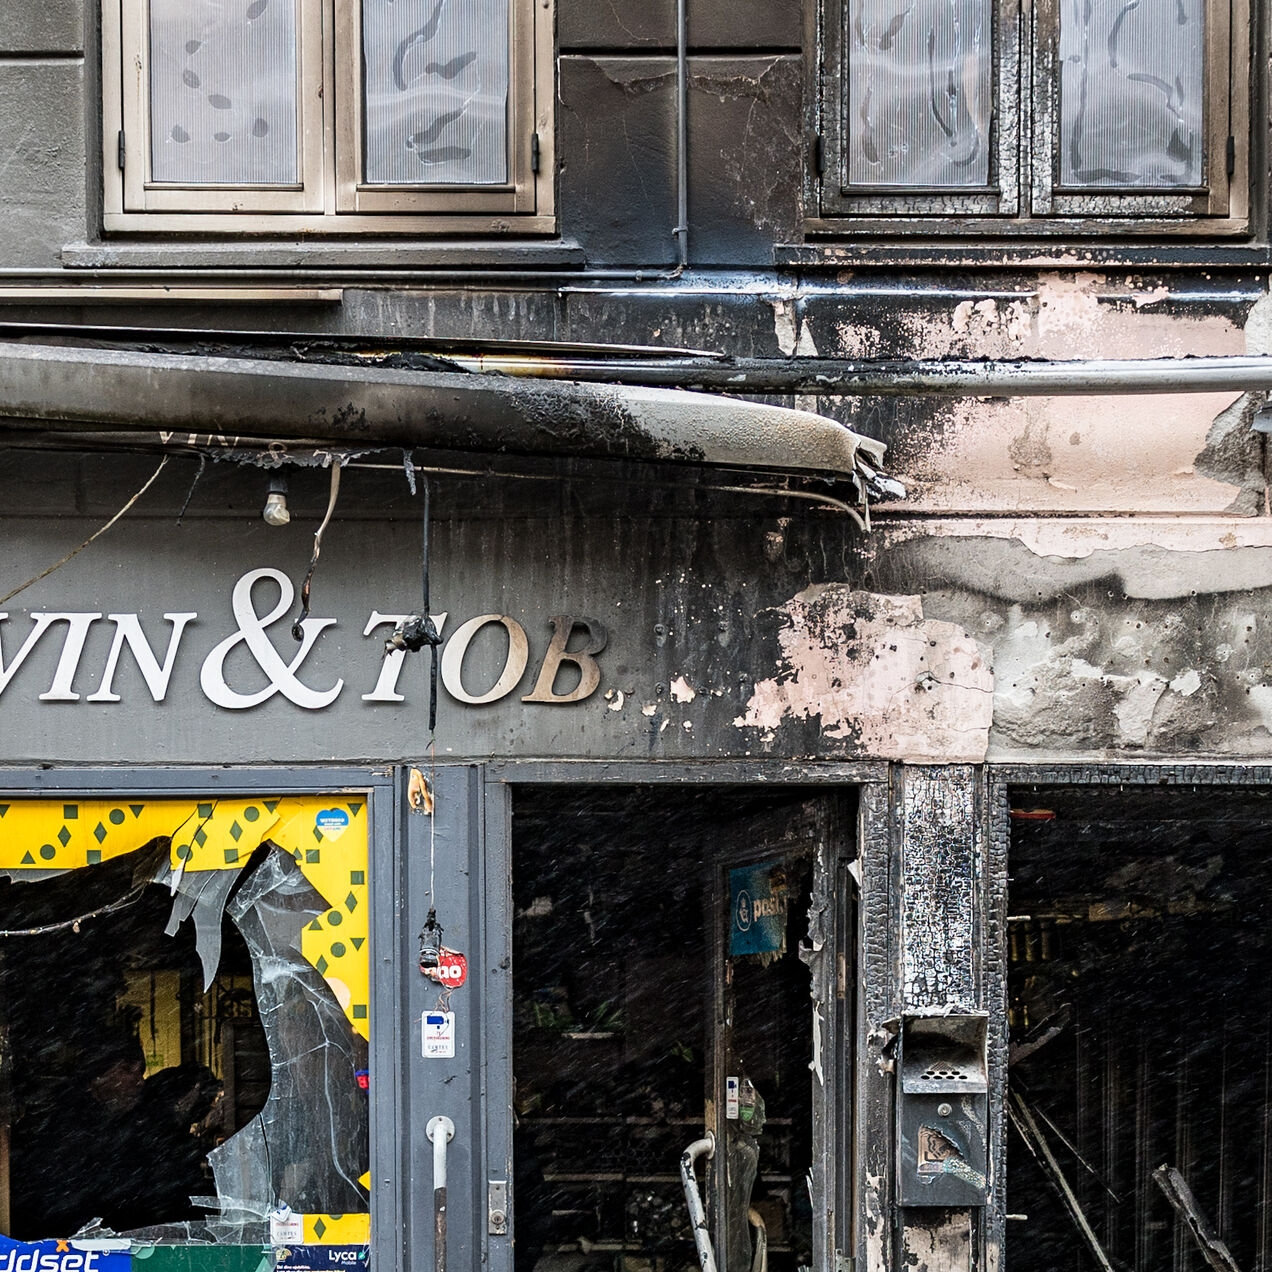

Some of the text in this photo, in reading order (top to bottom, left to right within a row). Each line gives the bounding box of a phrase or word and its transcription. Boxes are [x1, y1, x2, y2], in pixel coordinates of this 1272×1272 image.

[200, 567, 344, 710] &
[362, 610, 609, 705] TOB
[328, 1250, 357, 1263] Lyca
